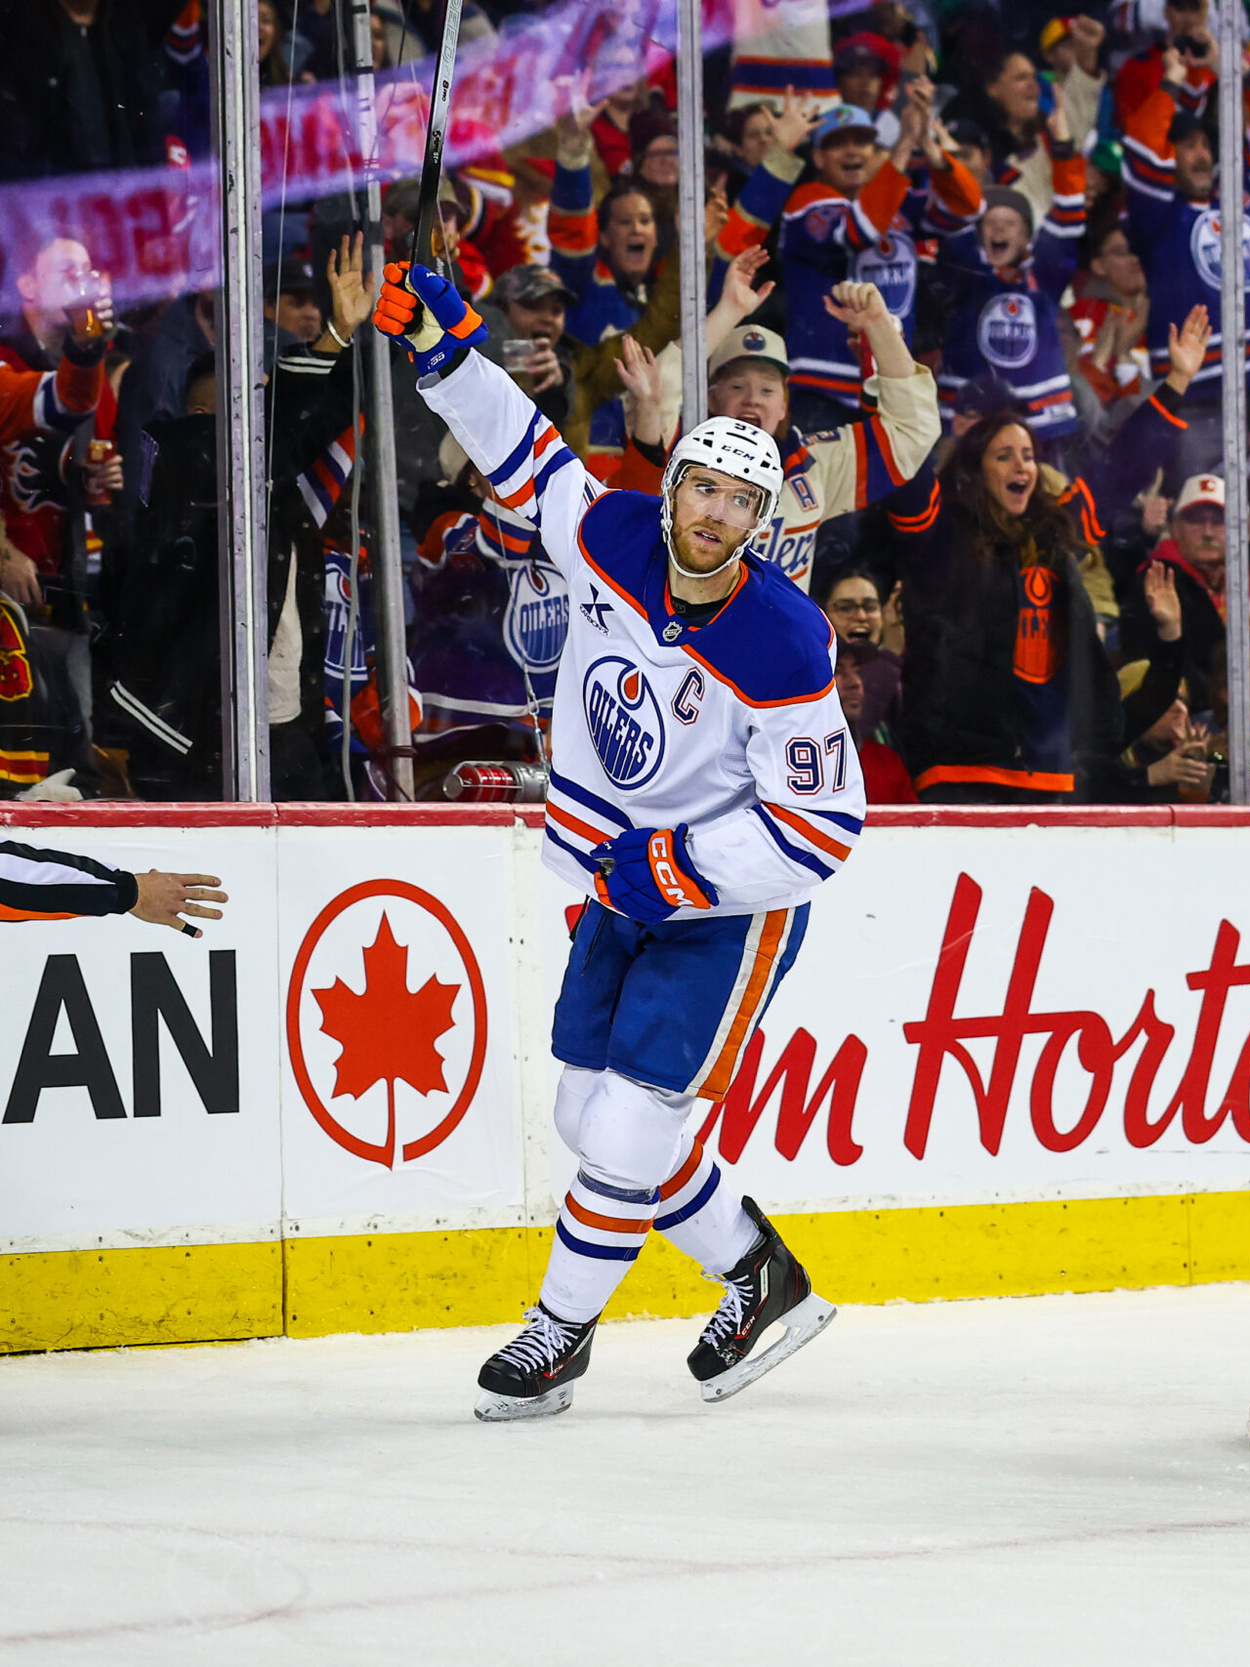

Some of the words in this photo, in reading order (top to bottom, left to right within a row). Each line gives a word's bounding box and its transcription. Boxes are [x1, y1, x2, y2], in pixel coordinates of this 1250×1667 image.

[721, 443, 756, 462] CCM
[589, 680, 655, 781] OILERS
[671, 665, 706, 727] C
[785, 726, 848, 796] 97
[651, 836, 696, 907] CCM
[2, 949, 240, 1125] AN
